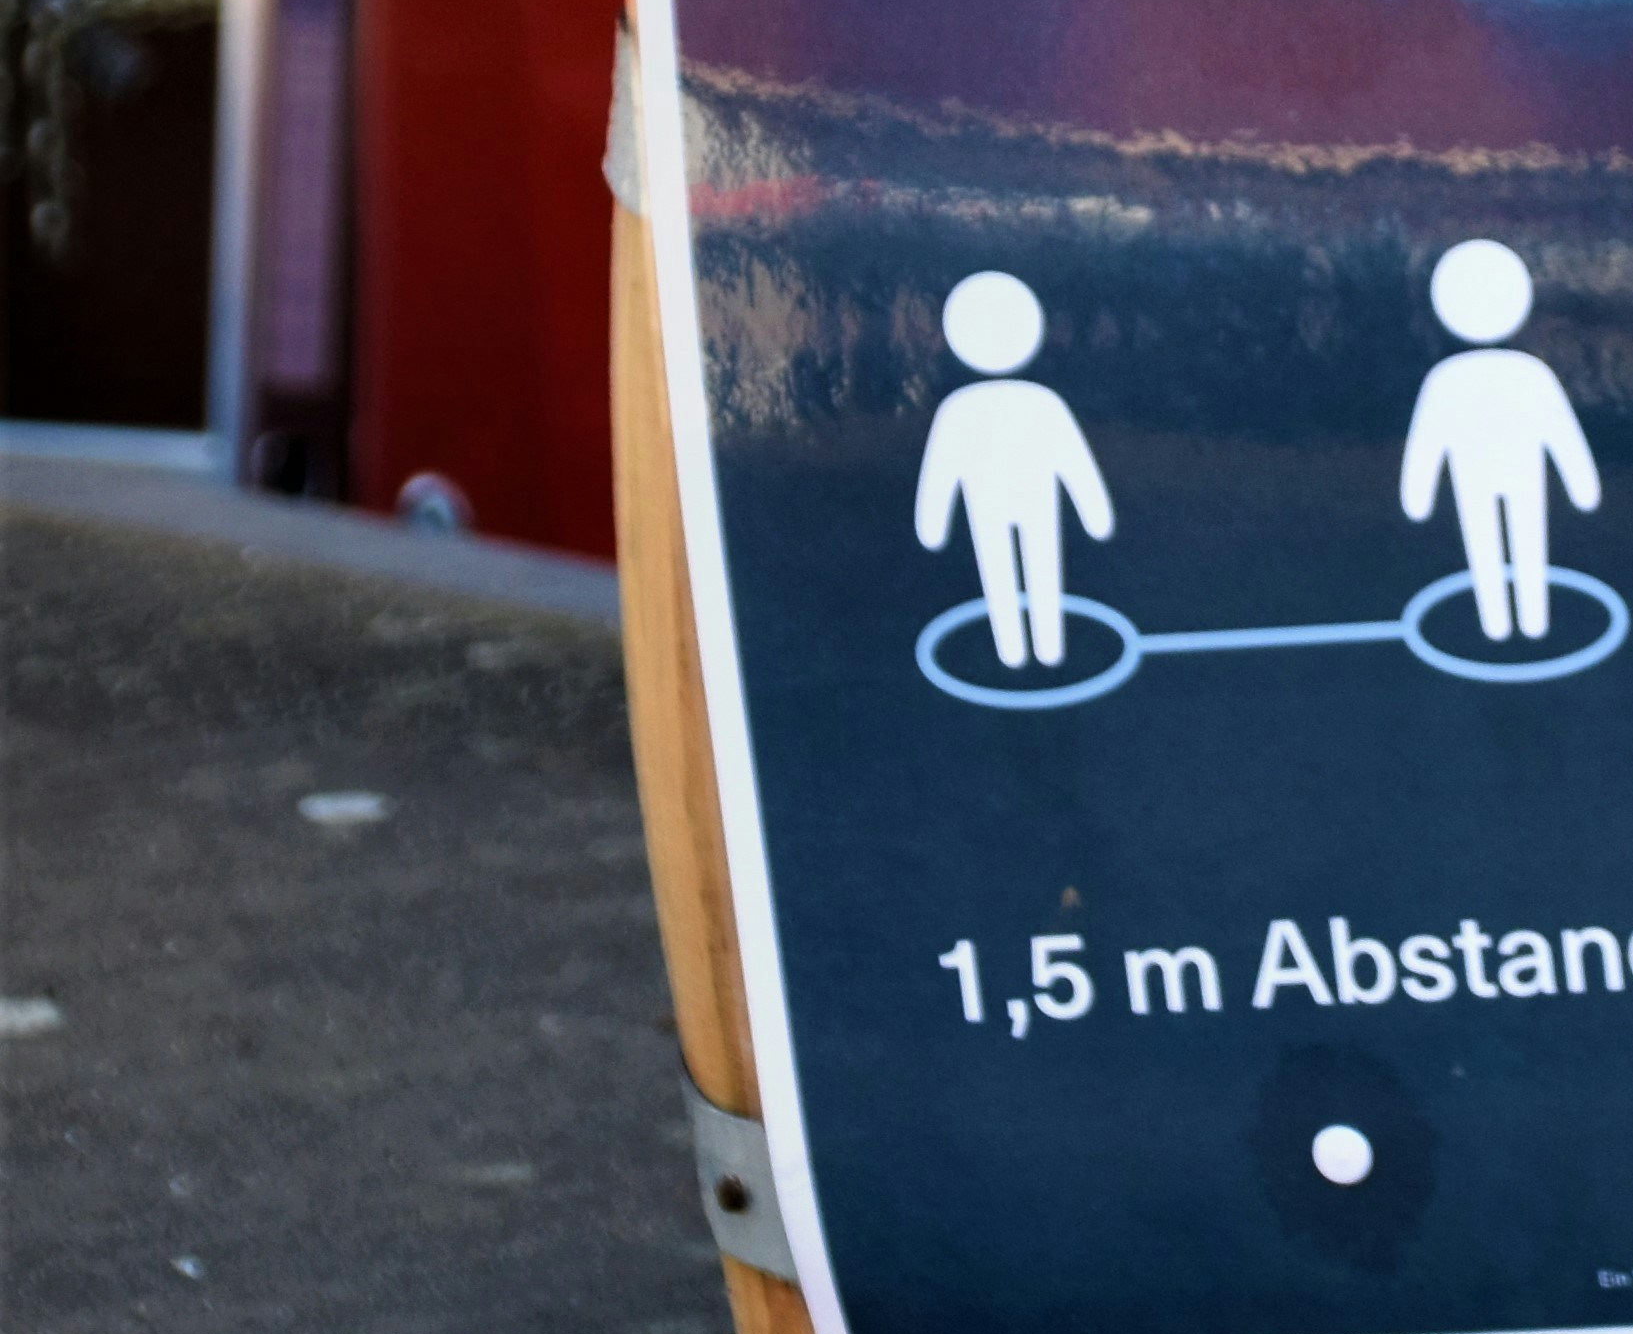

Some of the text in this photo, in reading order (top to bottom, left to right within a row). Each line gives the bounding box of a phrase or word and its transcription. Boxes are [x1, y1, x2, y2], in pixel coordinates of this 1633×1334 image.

[938, 933, 1095, 1039] 1,5
[1123, 946, 1223, 1014] m
[1598, 1268, 1631, 1288] Ein
